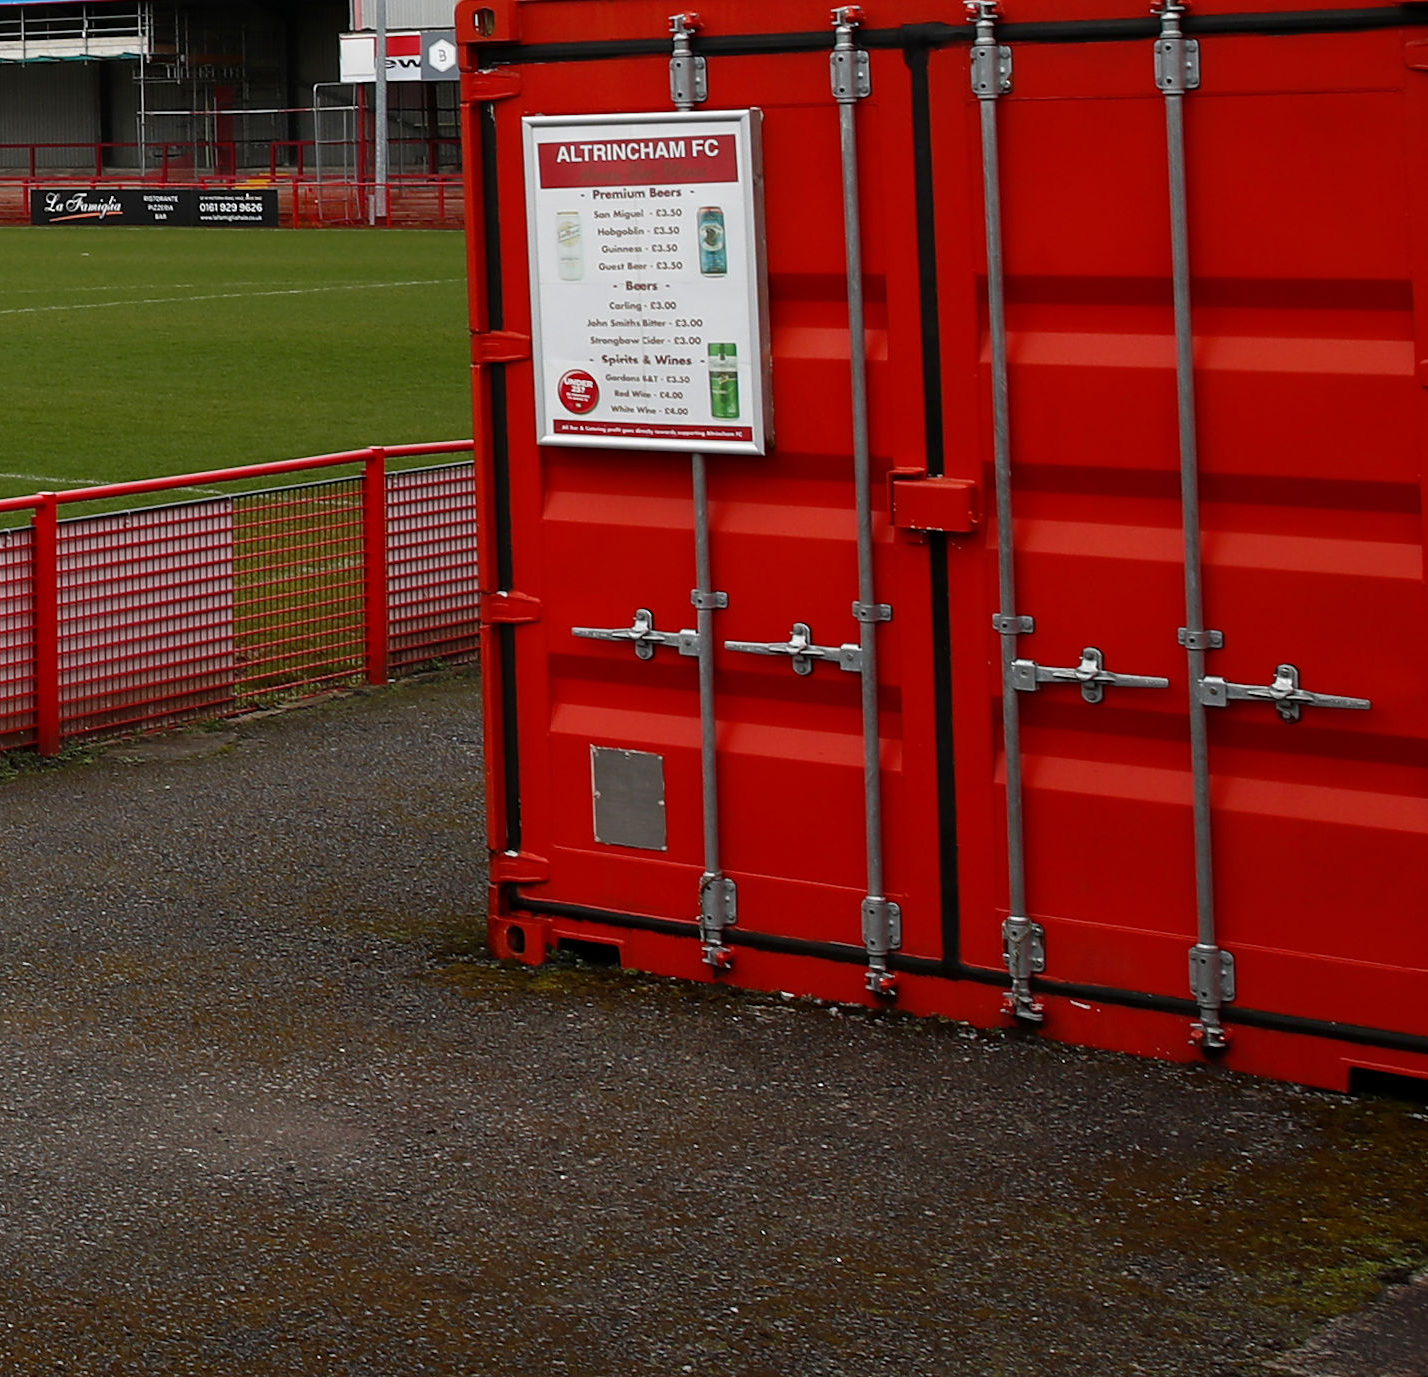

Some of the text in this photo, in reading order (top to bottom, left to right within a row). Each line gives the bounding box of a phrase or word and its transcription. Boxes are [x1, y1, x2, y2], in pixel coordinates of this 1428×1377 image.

[556, 138, 720, 163] ALTRINCHAM FC
[592, 187, 682, 201] Premium Beers
[44, 192, 122, 220] La Famiglia
[199, 203, 263, 213] 0161 929 9626
[593, 208, 683, 220] San Miguel £3.50
[597, 226, 680, 238] Hobgoblin £3.50
[601, 244, 678, 254] Guinness £3.50
[598, 262, 683, 271] Guest Beer £3.50
[625, 281, 658, 291] Beers
[608, 301, 677, 312] Carling £3.00
[642, 319, 666, 327] Bitter
[675, 319, 703, 327] £3.00
[674, 337, 702, 345] £3.00
[601, 355, 638, 366] Spirits
[655, 356, 692, 365] Wines
[614, 390, 630, 398] Red
[611, 405, 634, 413] White
[637, 407, 656, 415] Wine
